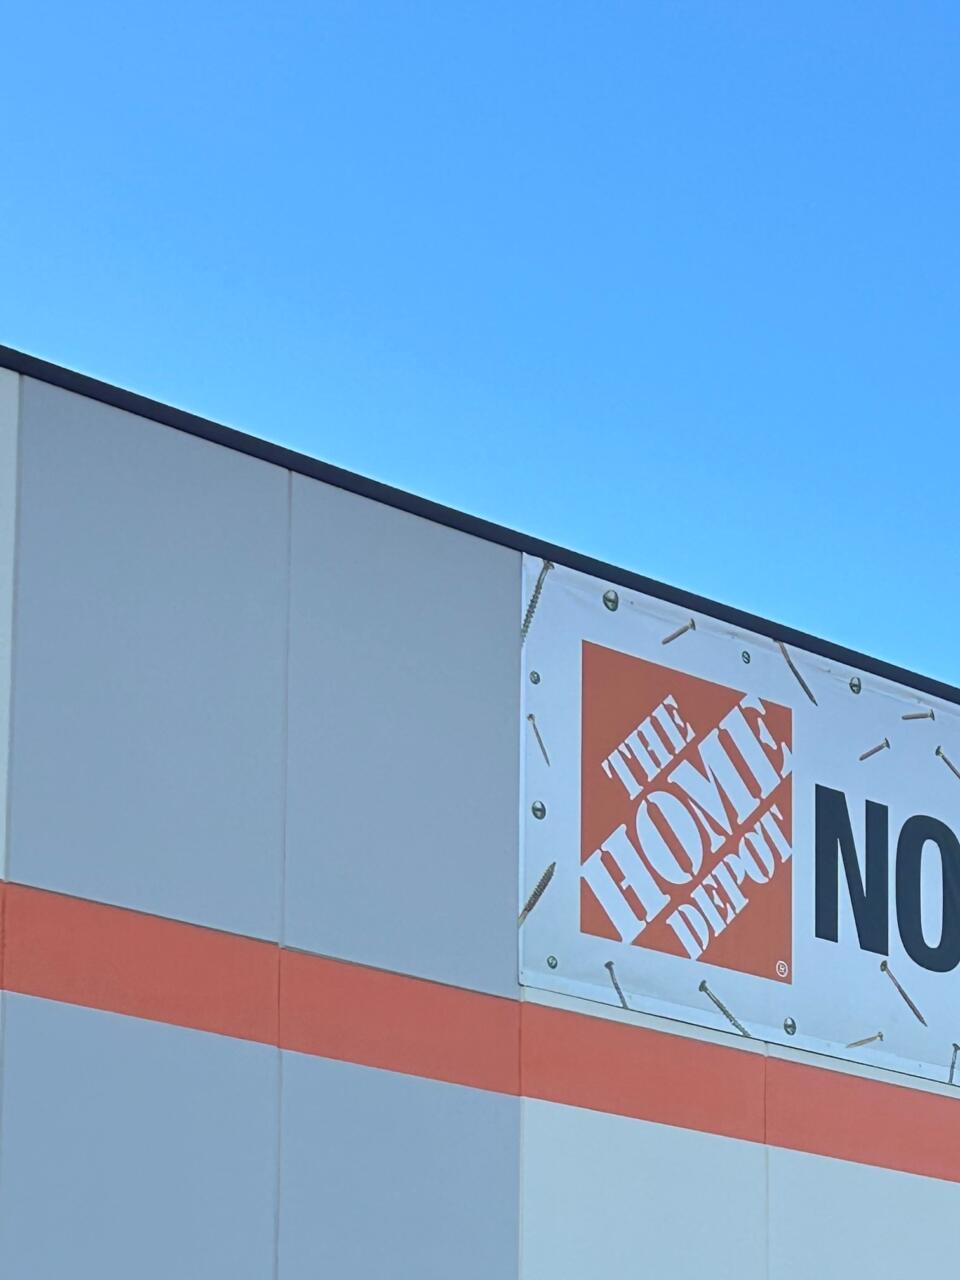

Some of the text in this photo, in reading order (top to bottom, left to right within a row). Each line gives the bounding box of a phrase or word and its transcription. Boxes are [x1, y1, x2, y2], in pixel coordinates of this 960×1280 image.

[580, 693, 792, 945] HOME
[601, 694, 696, 800] THE
[665, 804, 792, 961] DEPOT
